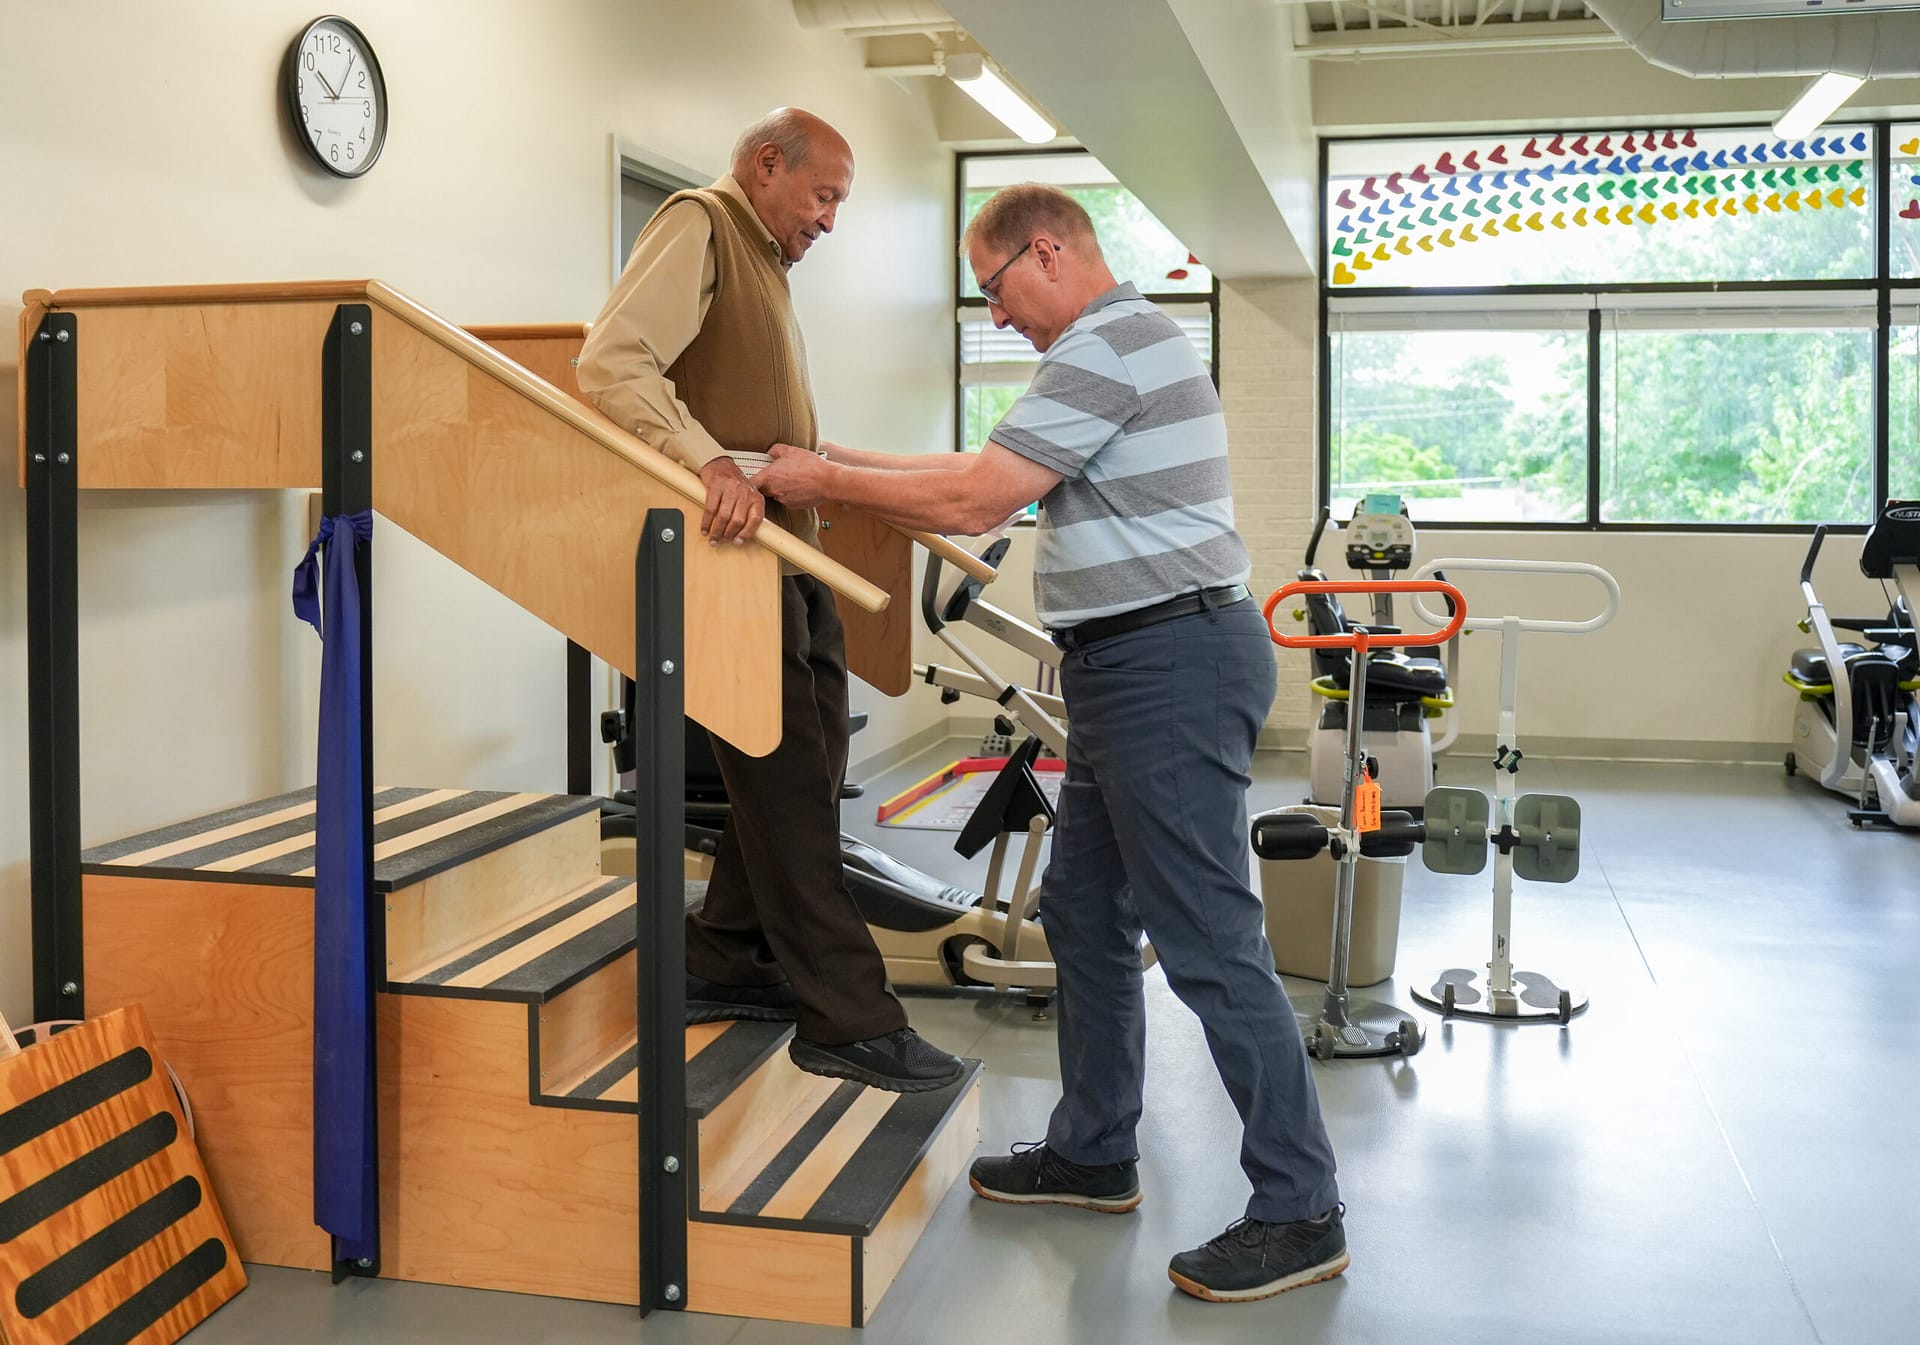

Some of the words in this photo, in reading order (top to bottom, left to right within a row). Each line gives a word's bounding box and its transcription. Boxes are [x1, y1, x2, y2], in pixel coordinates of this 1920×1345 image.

[313, 33, 324, 54] 11
[327, 33, 341, 54] 12
[302, 51, 315, 71] 10
[347, 48, 352, 65] 1
[358, 71, 366, 89] 2
[363, 100, 371, 118] 3
[314, 129, 322, 149] 7
[359, 126, 366, 144] 4
[331, 143, 339, 162] 6
[347, 141, 354, 160] 5
